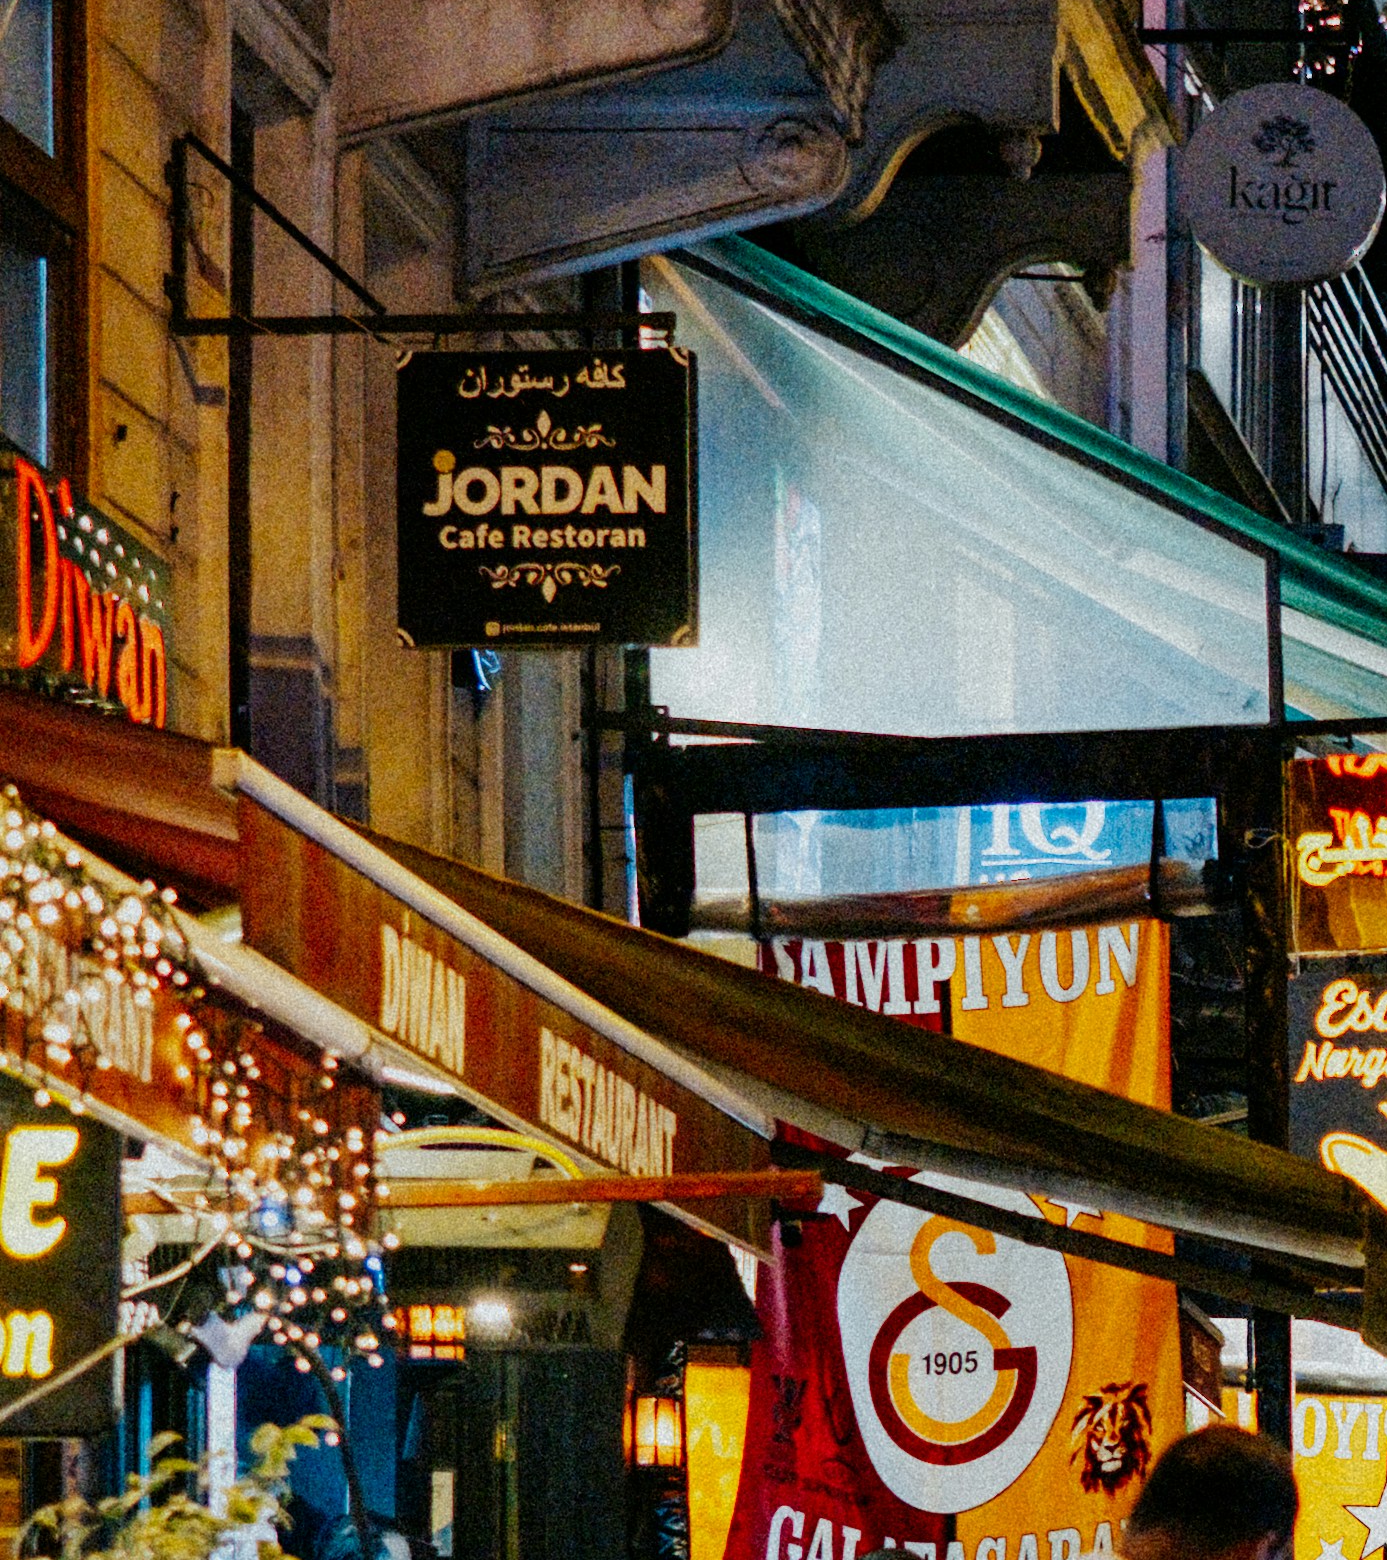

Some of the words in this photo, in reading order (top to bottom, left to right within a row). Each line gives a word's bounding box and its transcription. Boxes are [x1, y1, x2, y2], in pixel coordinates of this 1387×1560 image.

[439, 524, 505, 549] Cafe
[512, 525, 647, 550] Restoran
[921, 1349, 979, 1376] 1905
